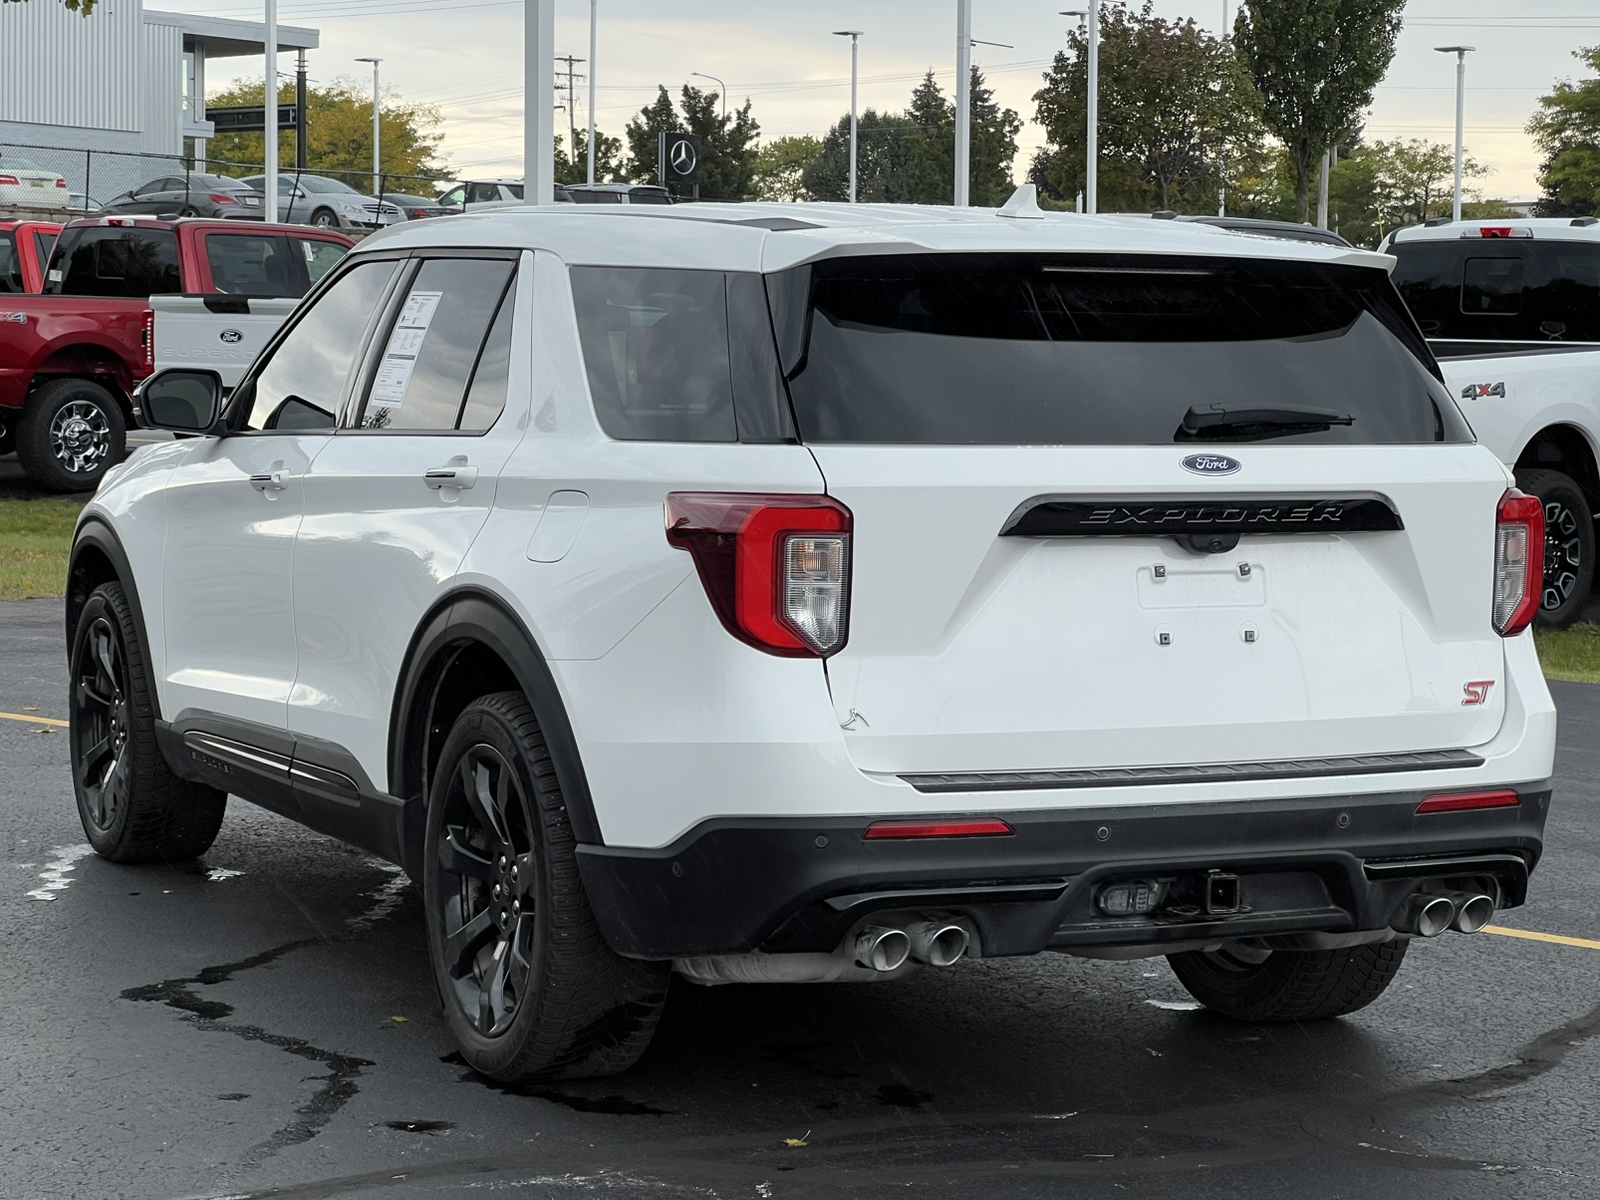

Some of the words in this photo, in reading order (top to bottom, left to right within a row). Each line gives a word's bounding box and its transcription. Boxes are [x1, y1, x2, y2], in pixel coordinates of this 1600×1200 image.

[161, 347, 238, 358] SUPER
[243, 349, 257, 359] D
[1078, 506, 1344, 524] EXPLORER
[1461, 680, 1495, 706] ST
